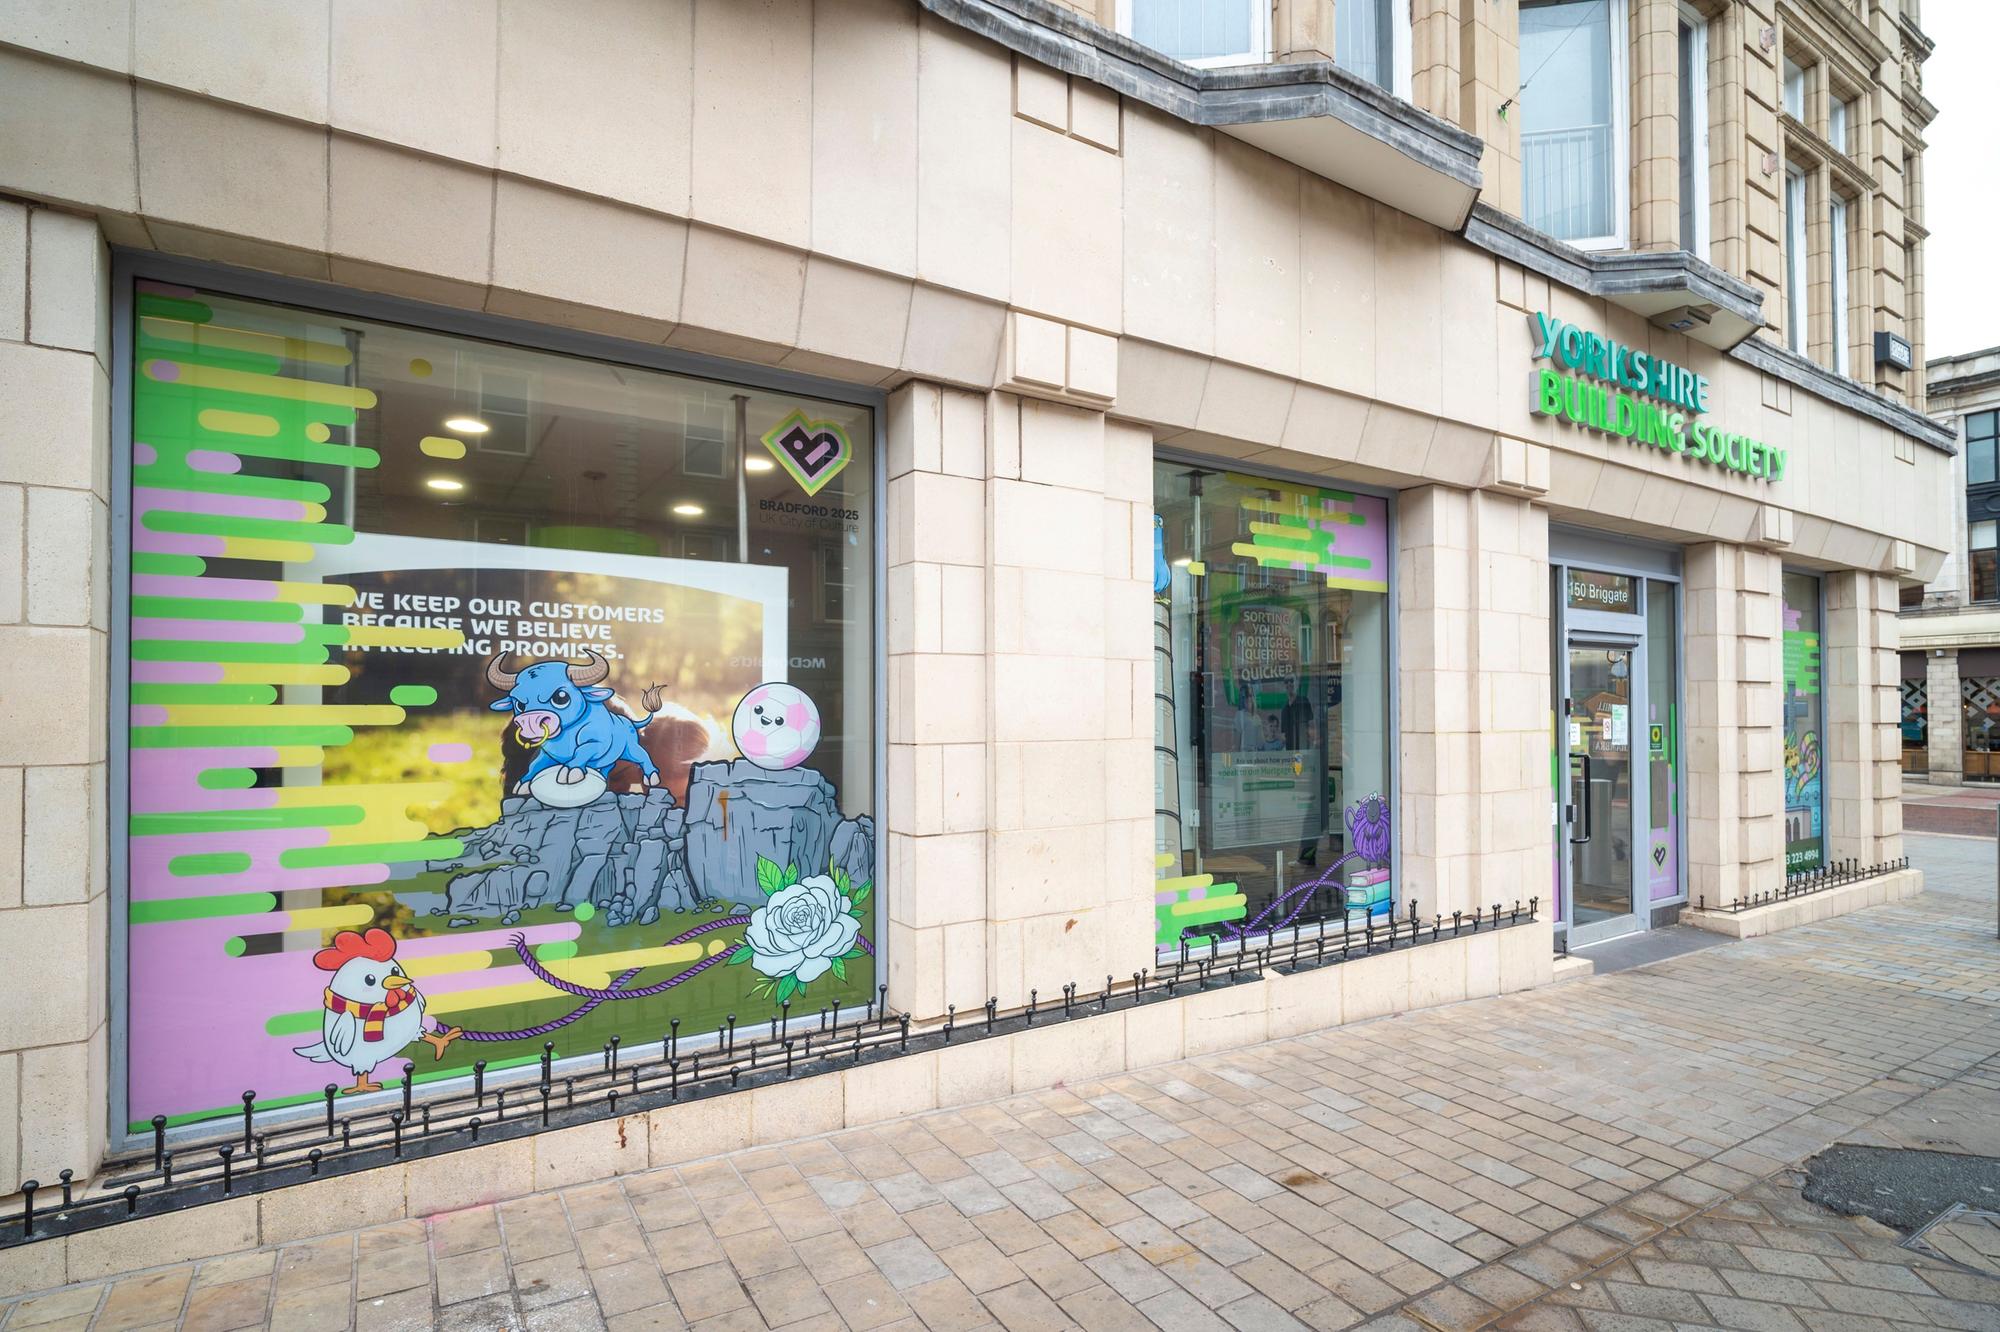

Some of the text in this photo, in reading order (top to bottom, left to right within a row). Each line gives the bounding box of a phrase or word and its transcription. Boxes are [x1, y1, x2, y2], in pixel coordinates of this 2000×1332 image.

[1529, 311, 1709, 413] YORKSHIRE
[1531, 368, 1787, 482] BUILDING SOCIETY
[760, 499, 859, 520] BRADFORD 2025
[760, 511, 859, 533] UK City of Culture
[1570, 582, 1628, 604] 150 Briggate
[393, 594, 460, 613] KEEP
[468, 598, 521, 616] OUR
[529, 601, 664, 623] CUSTOMERS
[1243, 611, 1290, 624] SORTING
[342, 613, 612, 640] BECAUSE WE BELIEVE
[1253, 623, 1282, 636] YOUR
[500, 640, 624, 660] PROMISES.
[1237, 635, 1296, 649] MORTGAGE
[1245, 648, 1289, 661] QUERIES
[1791, 851, 1803, 864] 223
